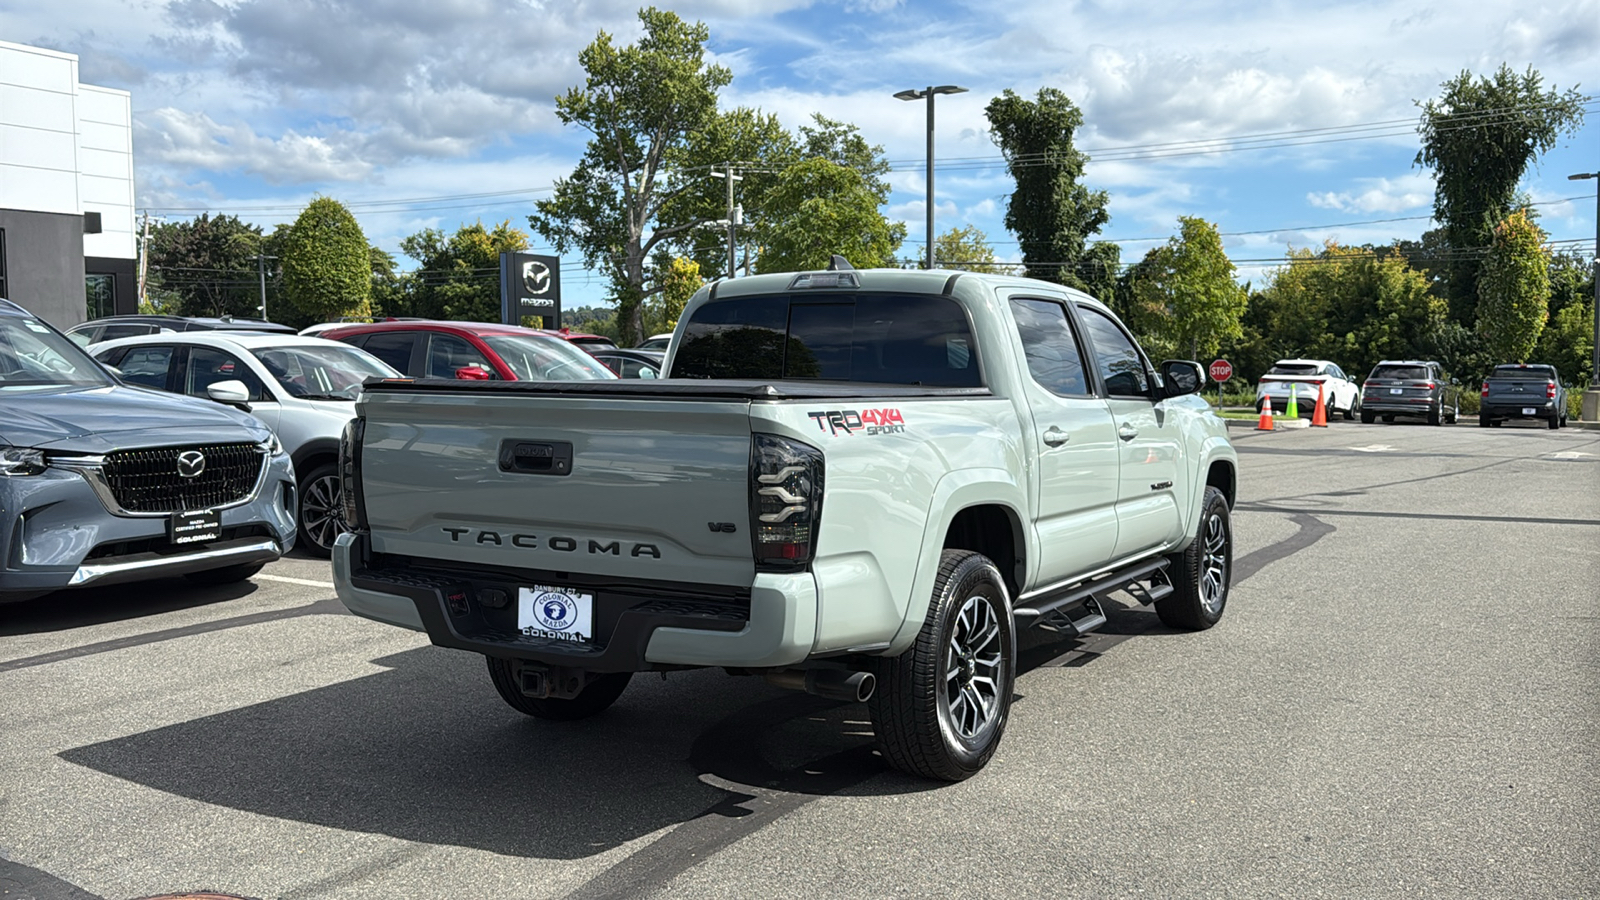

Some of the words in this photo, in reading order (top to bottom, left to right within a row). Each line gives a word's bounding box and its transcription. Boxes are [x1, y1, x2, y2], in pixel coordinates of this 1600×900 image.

[521, 298, 554, 307] mazda
[1211, 366, 1230, 376] STOP
[807, 410, 864, 437] TRD
[867, 425, 905, 435] SPORT
[708, 522, 736, 533] V6
[177, 534, 217, 544] COLONIAL
[442, 528, 661, 558] TACOMA
[567, 588, 576, 596] CT
[539, 594, 572, 609] COLONIAL
[543, 617, 568, 627] MAZDA
[522, 628, 586, 642] COLONIAL
